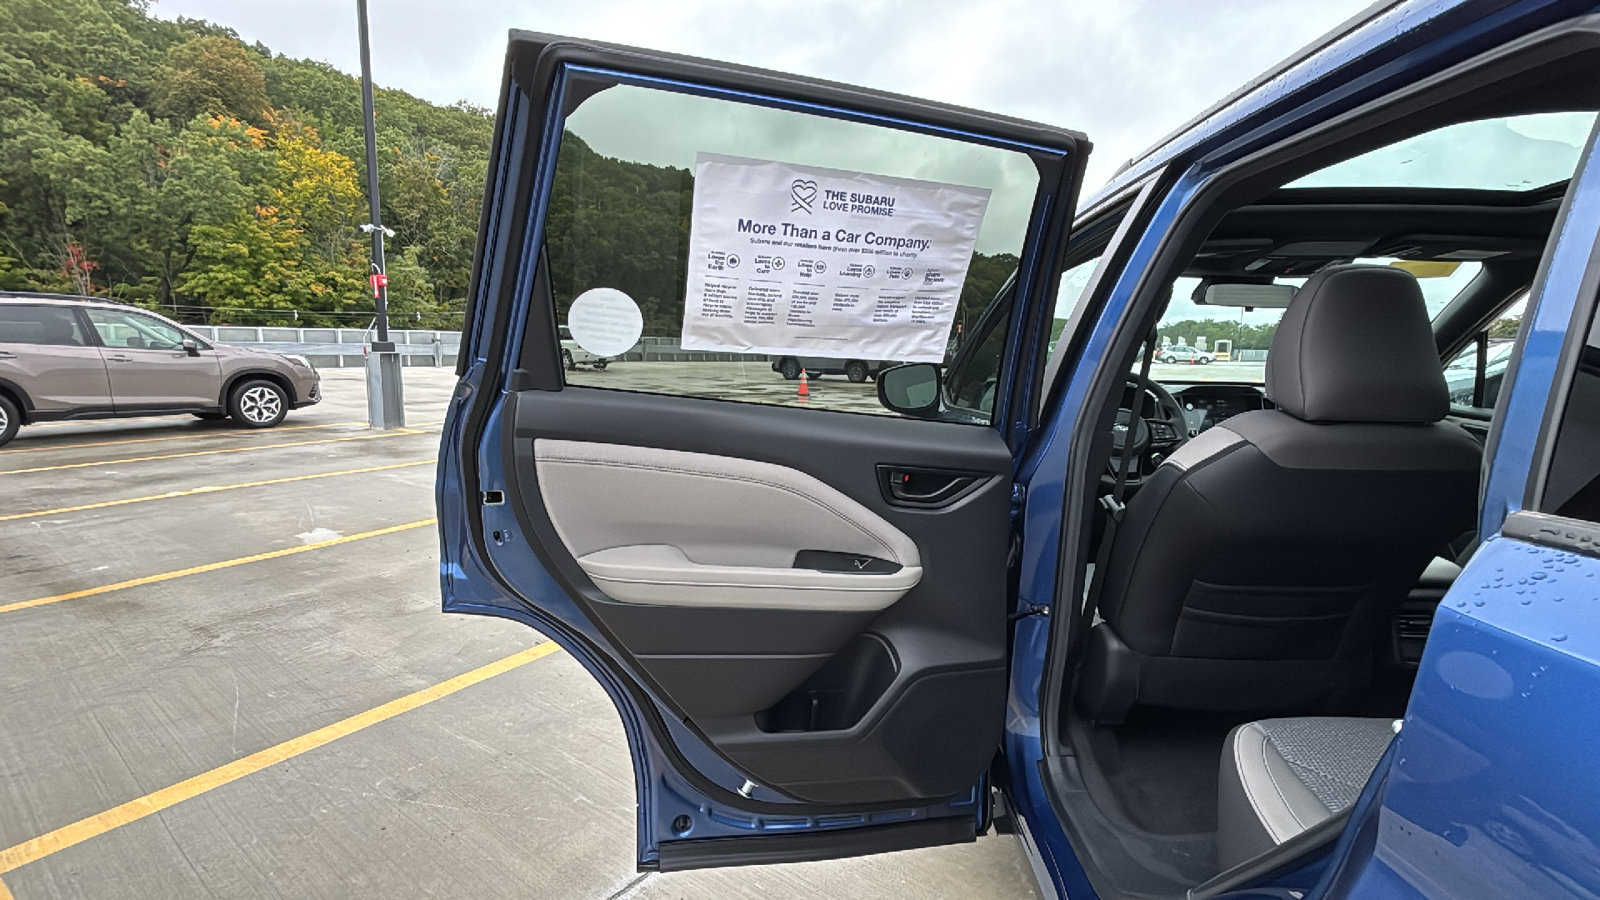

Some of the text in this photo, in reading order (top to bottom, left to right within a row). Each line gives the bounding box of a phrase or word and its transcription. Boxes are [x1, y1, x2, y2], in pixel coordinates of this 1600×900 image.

[825, 190, 895, 207] THE SUBARU
[823, 201, 894, 217] LOVE PROMISE
[738, 218, 776, 235] More
[781, 223, 817, 239] Than
[822, 231, 831, 240] a
[835, 229, 861, 244] Car
